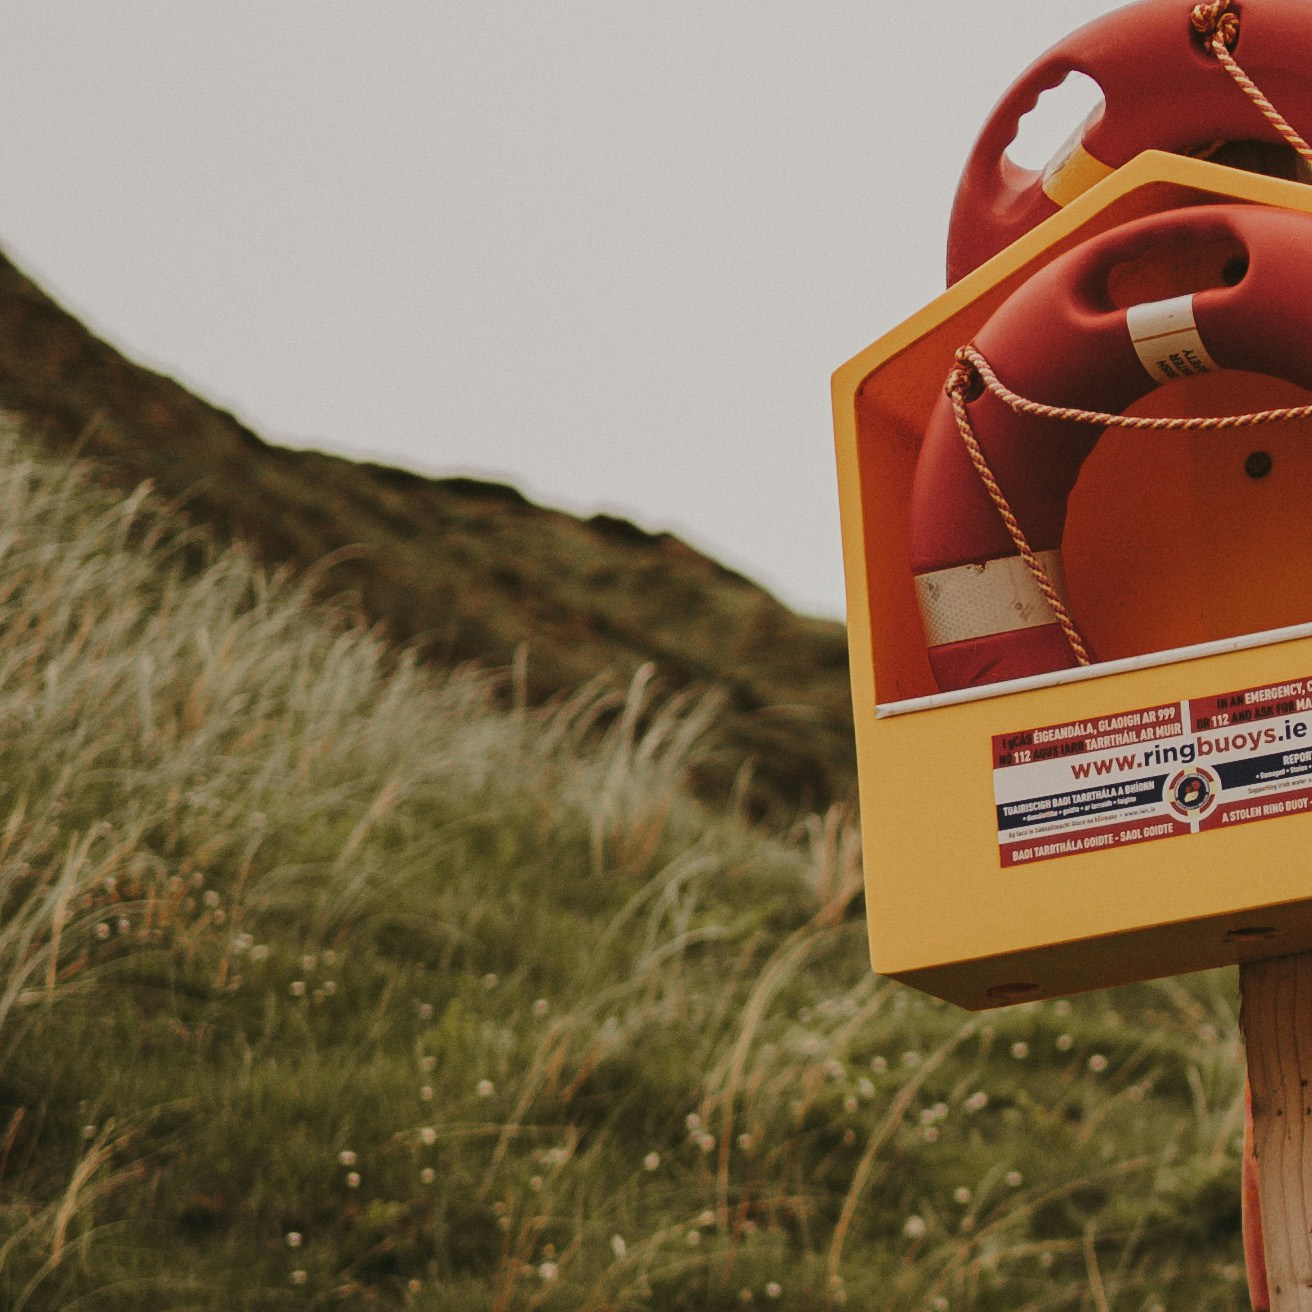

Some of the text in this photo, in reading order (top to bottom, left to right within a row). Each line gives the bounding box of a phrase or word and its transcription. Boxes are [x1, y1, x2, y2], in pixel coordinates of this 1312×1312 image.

[1245, 682, 1305, 705] EMERGENCY,
[1034, 722, 1097, 744] ÉIGEANDÁLA,
[1099, 713, 1141, 732] GLAOIGH
[1142, 710, 1156, 723] AR
[1158, 707, 1175, 720] 999
[1211, 713, 1229, 727] 112
[1014, 750, 1031, 764] 112
[1085, 731, 1138, 751] TARRTHÁIL
[1140, 728, 1154, 741] AR
[1156, 722, 1181, 737] MUIR
[1071, 719, 1308, 780] www.ringbuoys.ie
[1118, 786, 1124, 795] A
[1222, 813, 1230, 822] A
[1230, 806, 1262, 822] STOLEN
[1263, 801, 1284, 815] RING
[1286, 798, 1308, 811] BUOY
[1012, 848, 1032, 862] BAOI
[1034, 837, 1083, 857] TARRTHÁLA
[1084, 833, 1114, 848] GOIDTE
[1120, 828, 1142, 843] SAOL
[1144, 822, 1173, 838] GOIDTE
